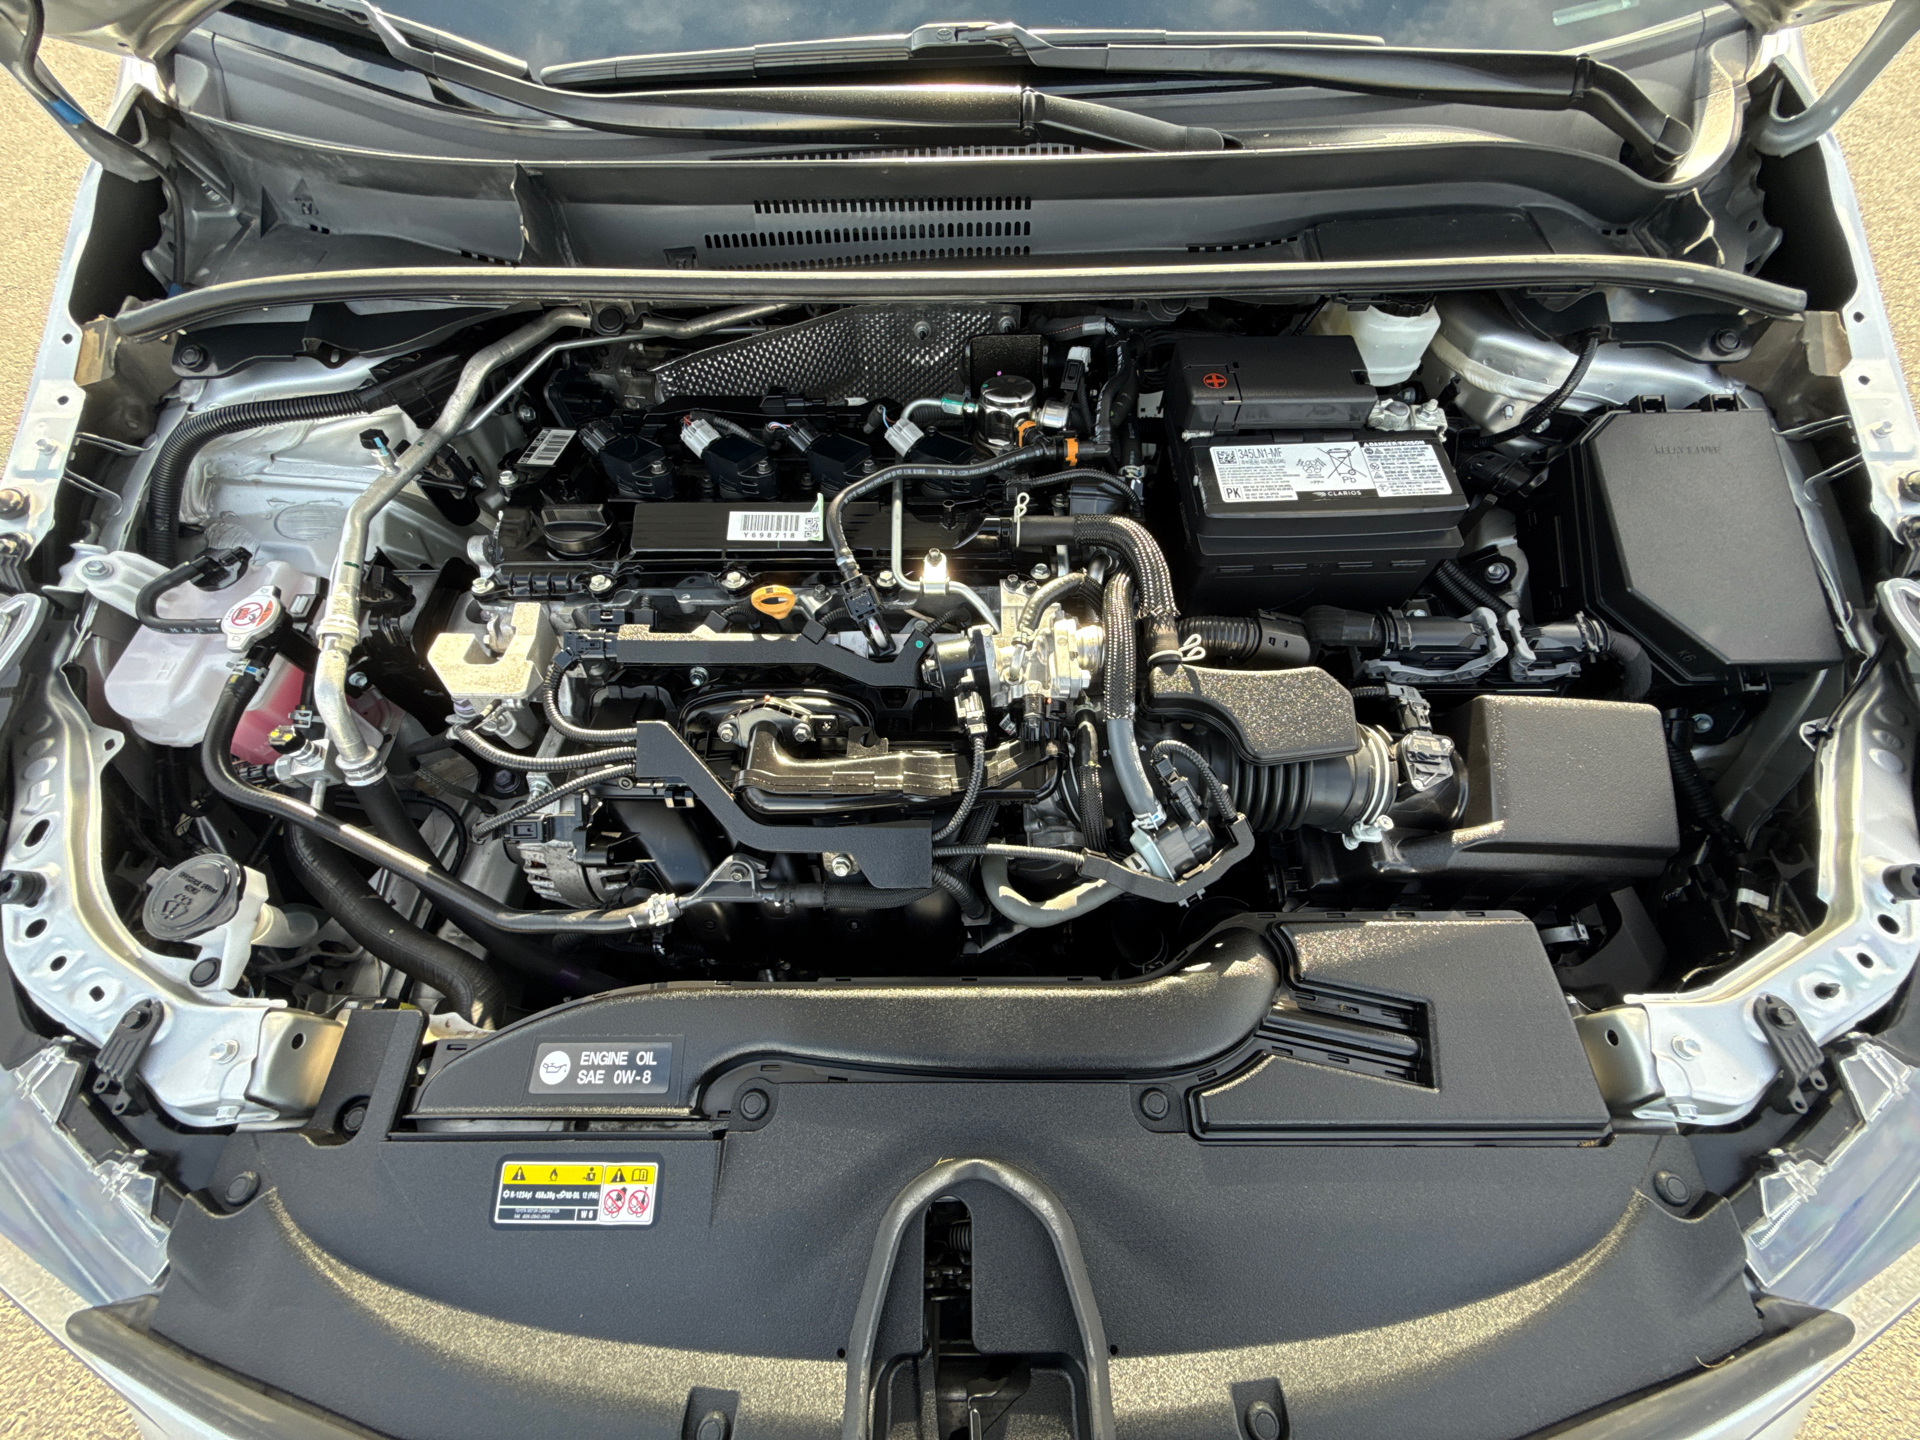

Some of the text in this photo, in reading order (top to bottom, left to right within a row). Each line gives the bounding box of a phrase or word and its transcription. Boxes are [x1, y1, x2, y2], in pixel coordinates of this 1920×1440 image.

[1238, 448, 1282, 459] 345LN1-MF
[1342, 476, 1357, 484] Pb
[1226, 487, 1241, 499] PK
[580, 1051, 658, 1066] ENGINE OIL
[576, 1069, 652, 1085] SAE 0W-8
[581, 1210, 588, 1219] W
